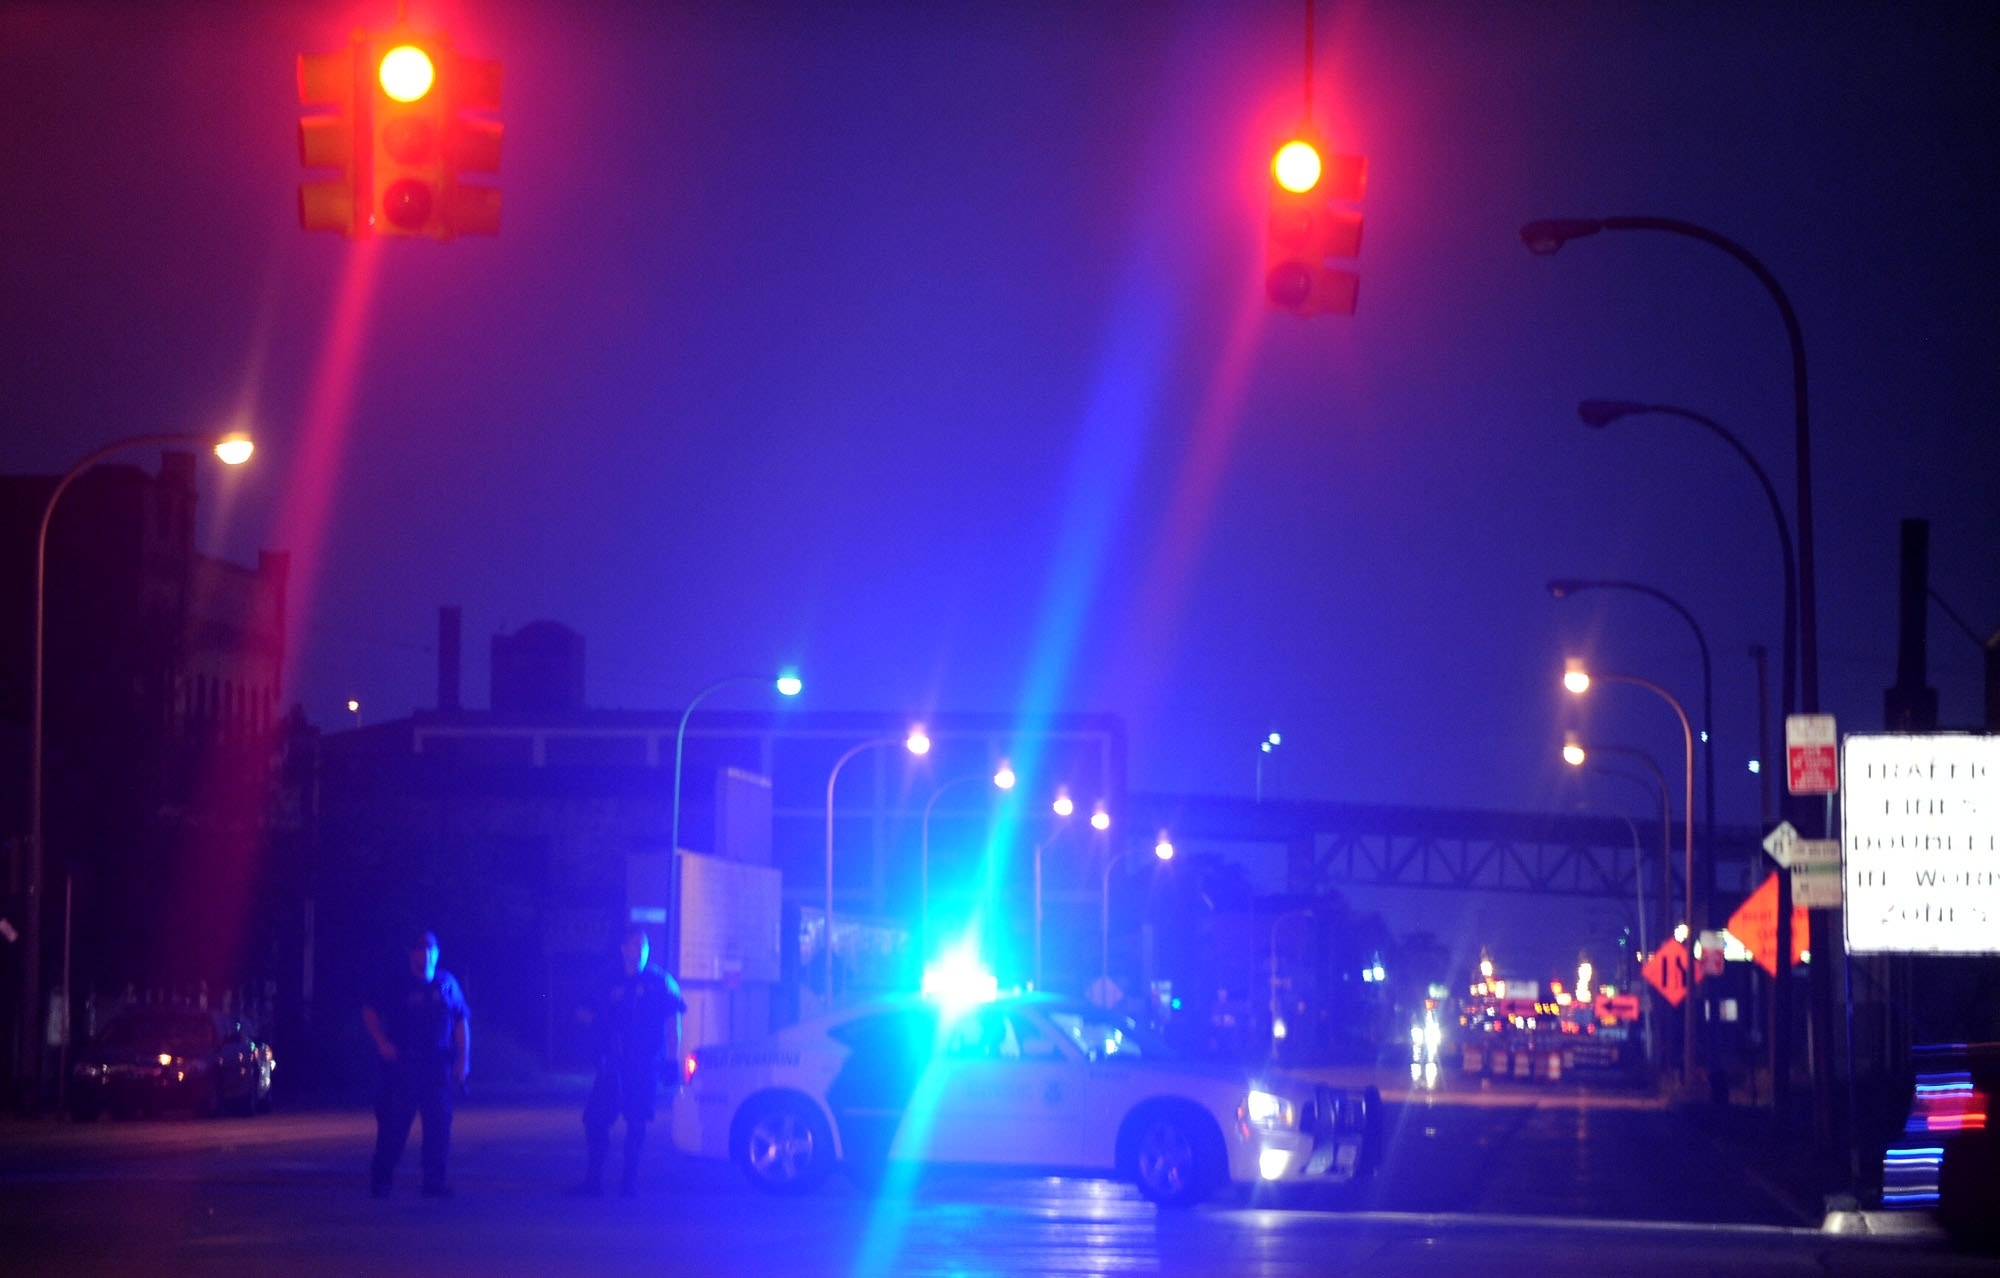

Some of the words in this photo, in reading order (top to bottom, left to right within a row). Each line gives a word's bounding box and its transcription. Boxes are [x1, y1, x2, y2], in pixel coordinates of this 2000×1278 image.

[1884, 798, 1977, 816] FINES
[1857, 870, 1887, 888] IN
[1881, 903, 1988, 924] ZONES
